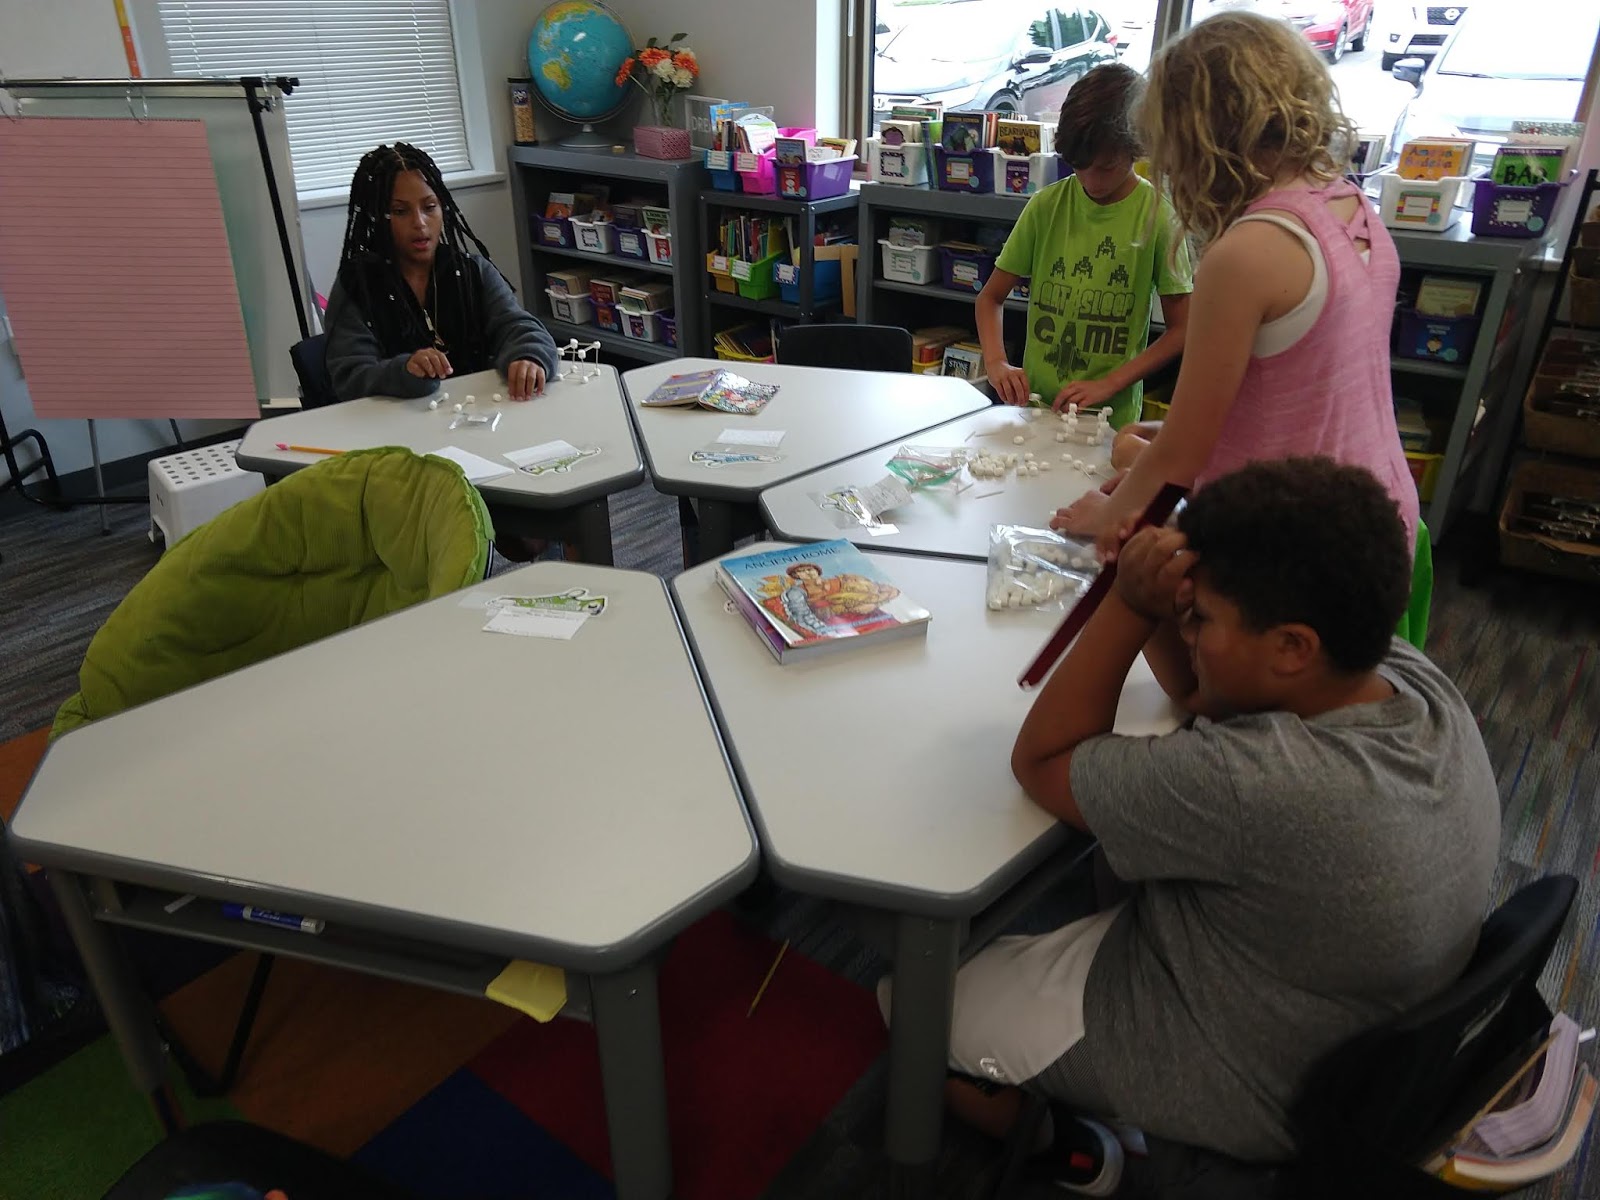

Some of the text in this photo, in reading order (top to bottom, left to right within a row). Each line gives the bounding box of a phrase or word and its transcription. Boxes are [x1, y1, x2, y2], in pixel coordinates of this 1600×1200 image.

[1000, 126, 1040, 138] BEARHAVEN
[1505, 165, 1549, 185] BAD
[1038, 281, 1136, 322] EAT SLEEP
[1034, 315, 1130, 355] GAME
[948, 359, 969, 370] STONE
[744, 546, 841, 570] ANCIENT ROME
